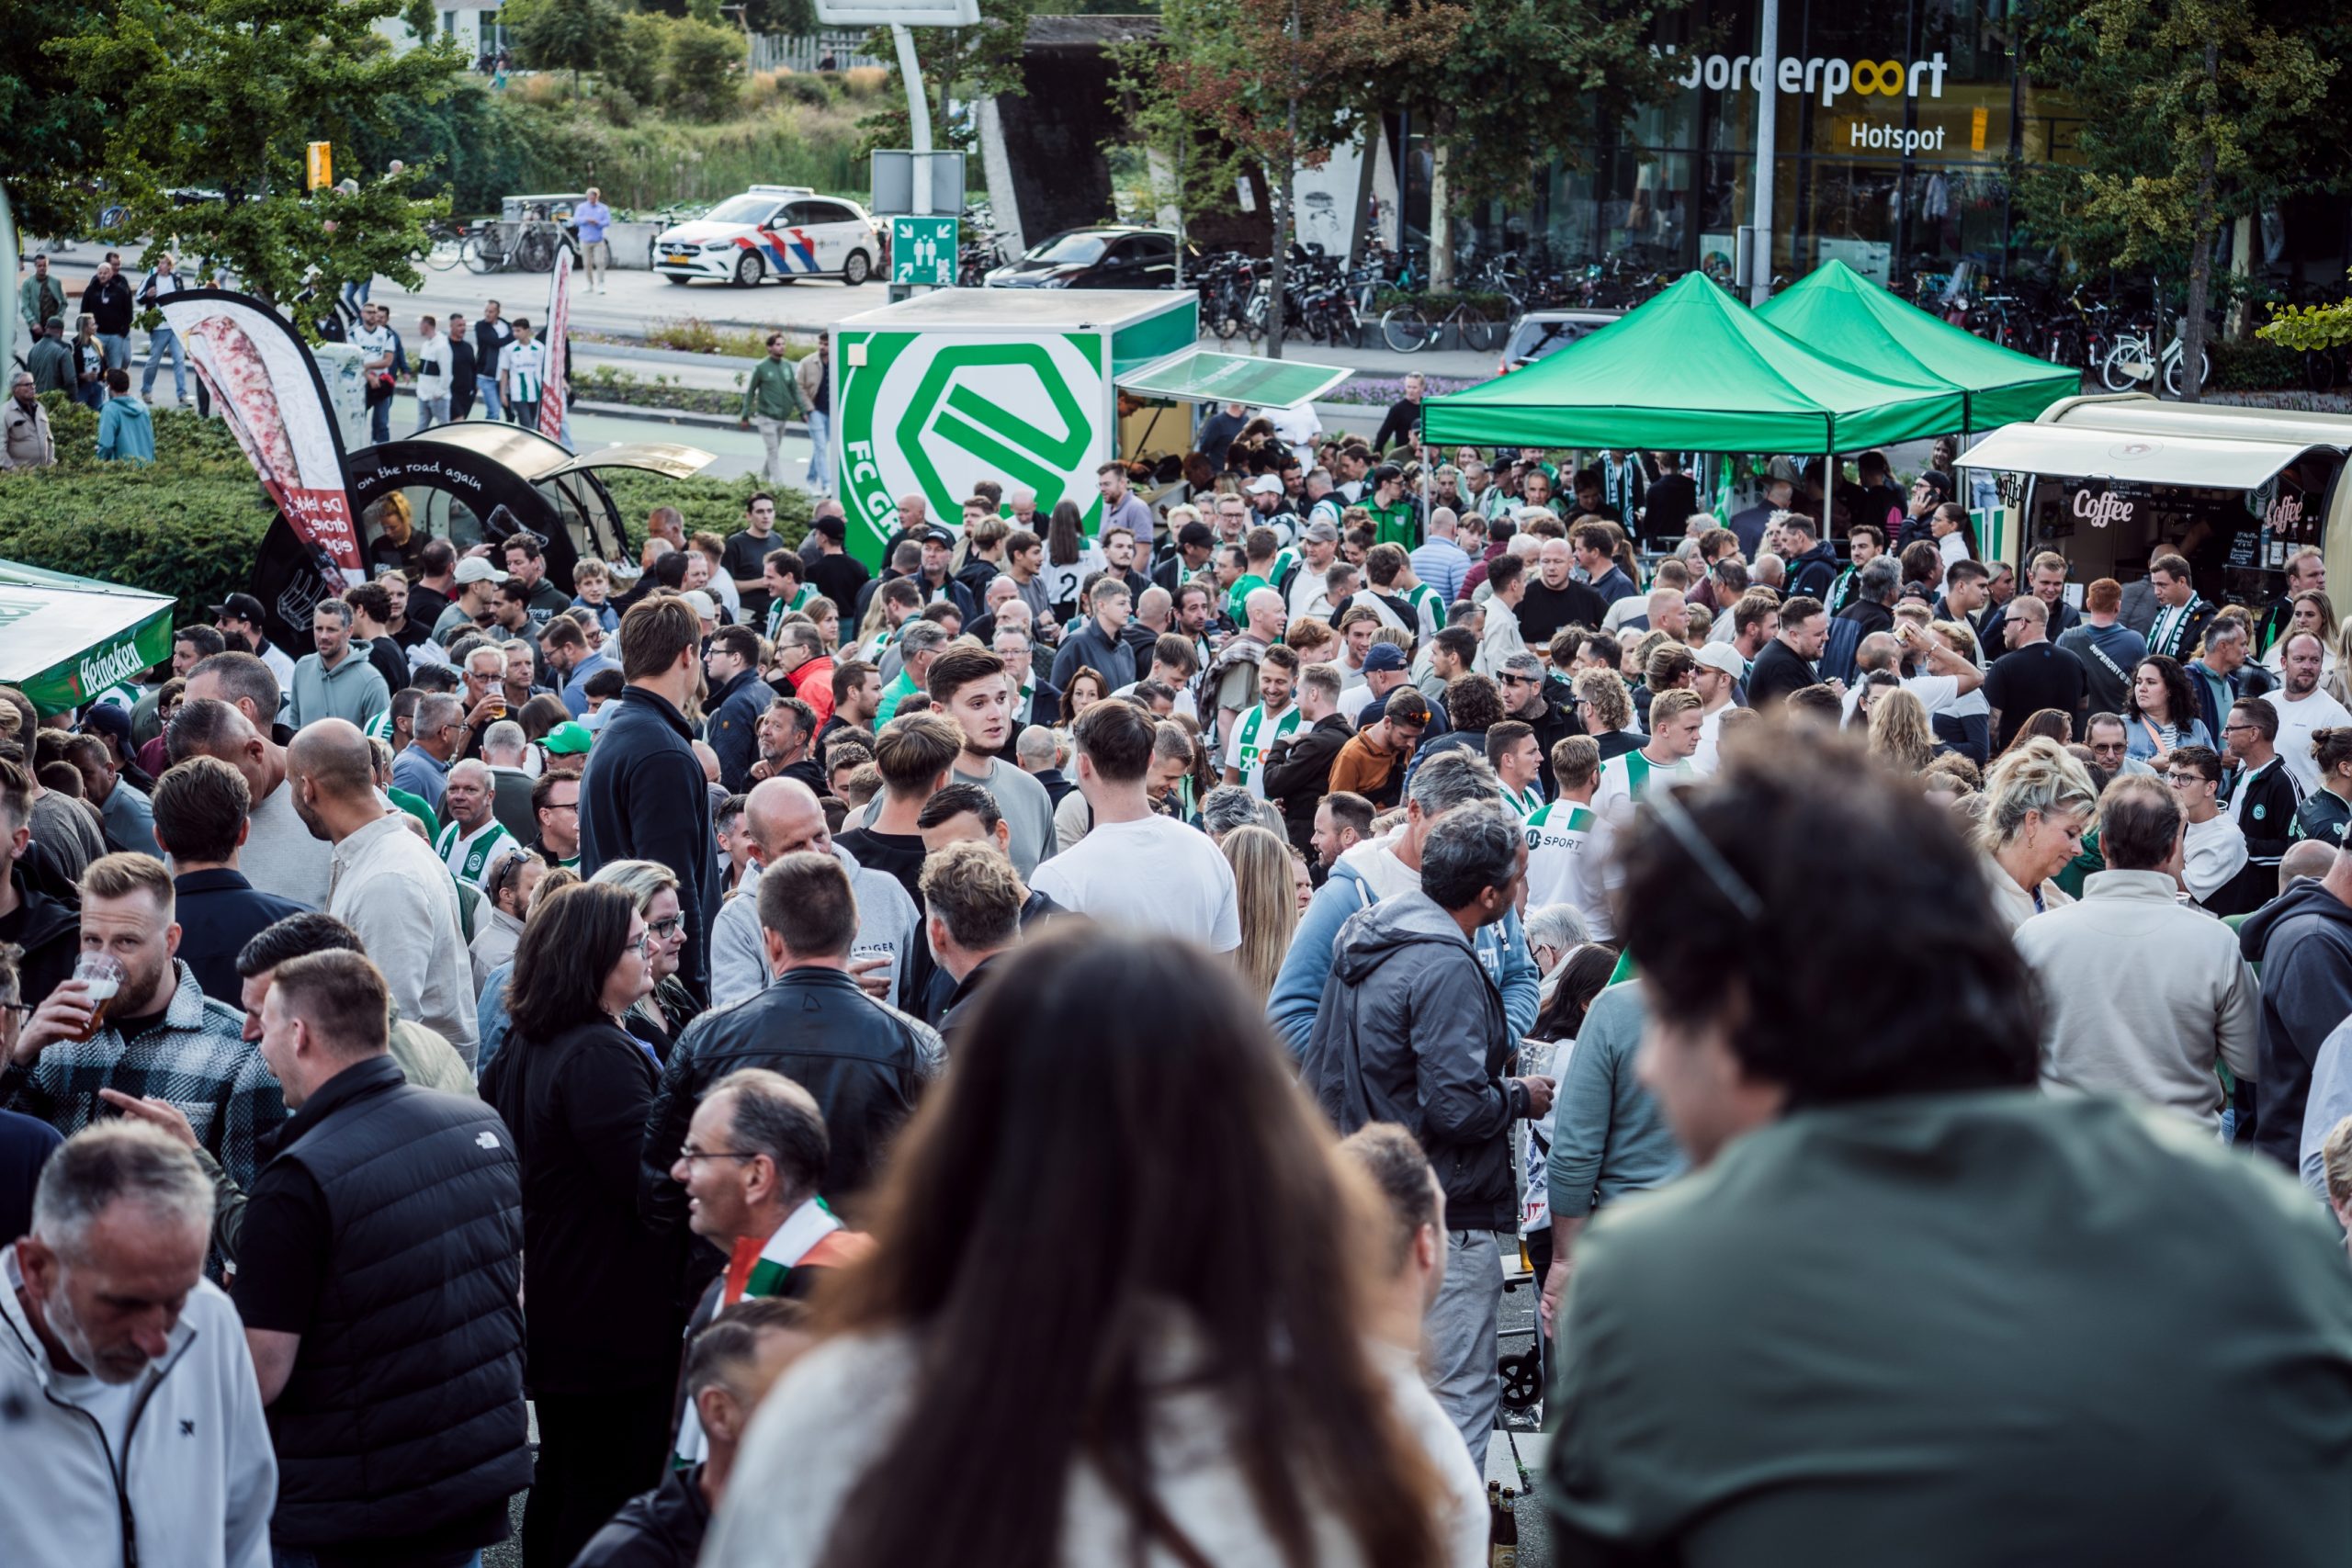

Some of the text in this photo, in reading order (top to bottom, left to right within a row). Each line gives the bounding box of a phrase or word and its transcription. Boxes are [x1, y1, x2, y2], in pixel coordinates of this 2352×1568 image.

[1649, 44, 1948, 107] oorerpoort
[1850, 122, 1946, 156] Hotspot
[357, 461, 482, 491] on the road again
[847, 440, 877, 483] FC
[2073, 489, 2134, 529] Coffee
[2266, 494, 2303, 535] Coffee
[1060, 572, 1077, 603] 2
[80, 641, 144, 698] Heineken
[1544, 836, 1584, 851] SPORT
